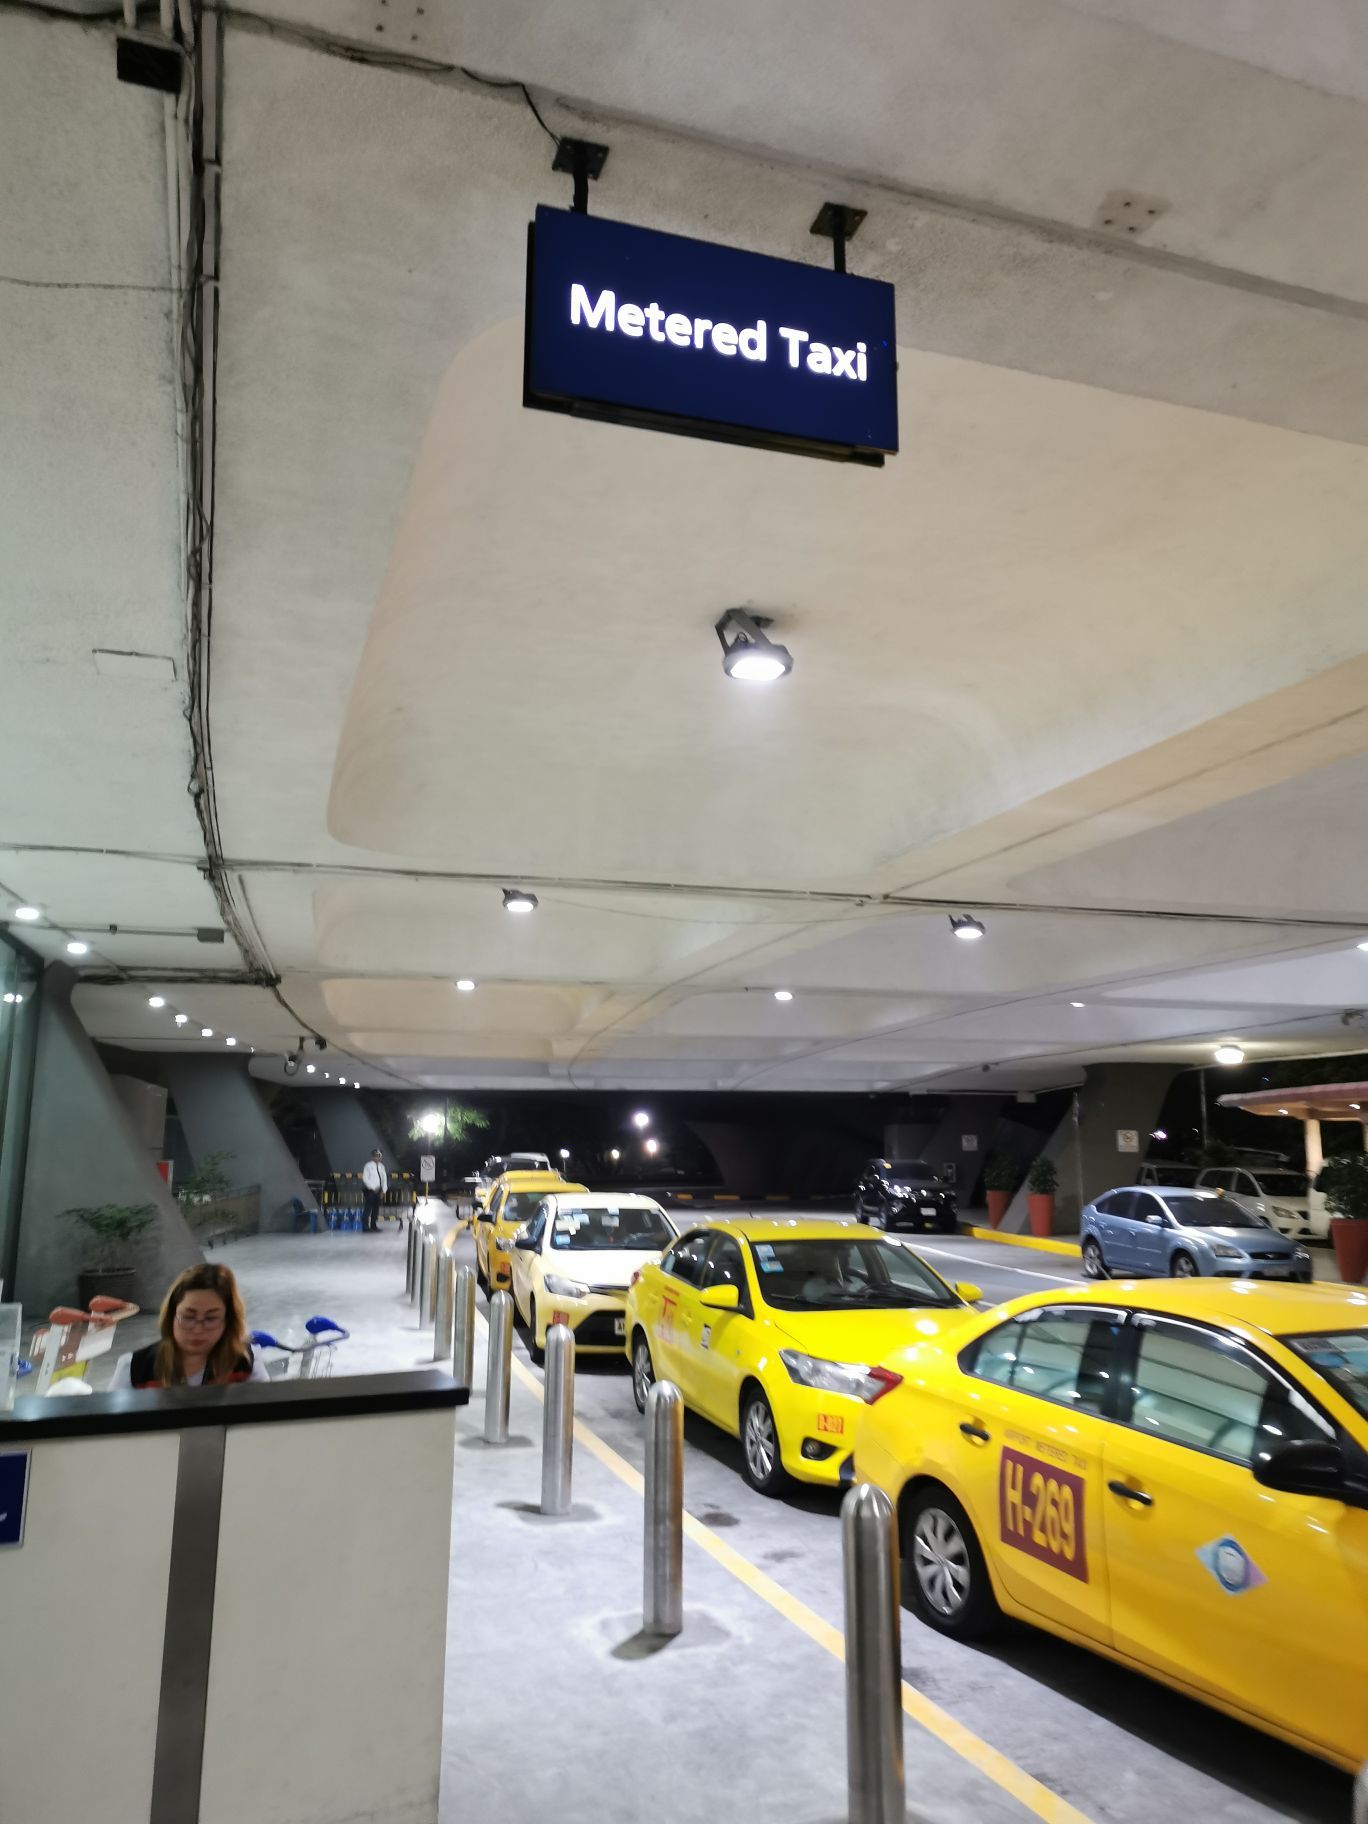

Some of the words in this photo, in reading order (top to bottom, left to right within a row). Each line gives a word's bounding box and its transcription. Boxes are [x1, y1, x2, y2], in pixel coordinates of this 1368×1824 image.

[570, 283, 767, 362] Metered
[778, 326, 868, 382] Taxi
[1005, 1458, 1076, 1562] H-269
